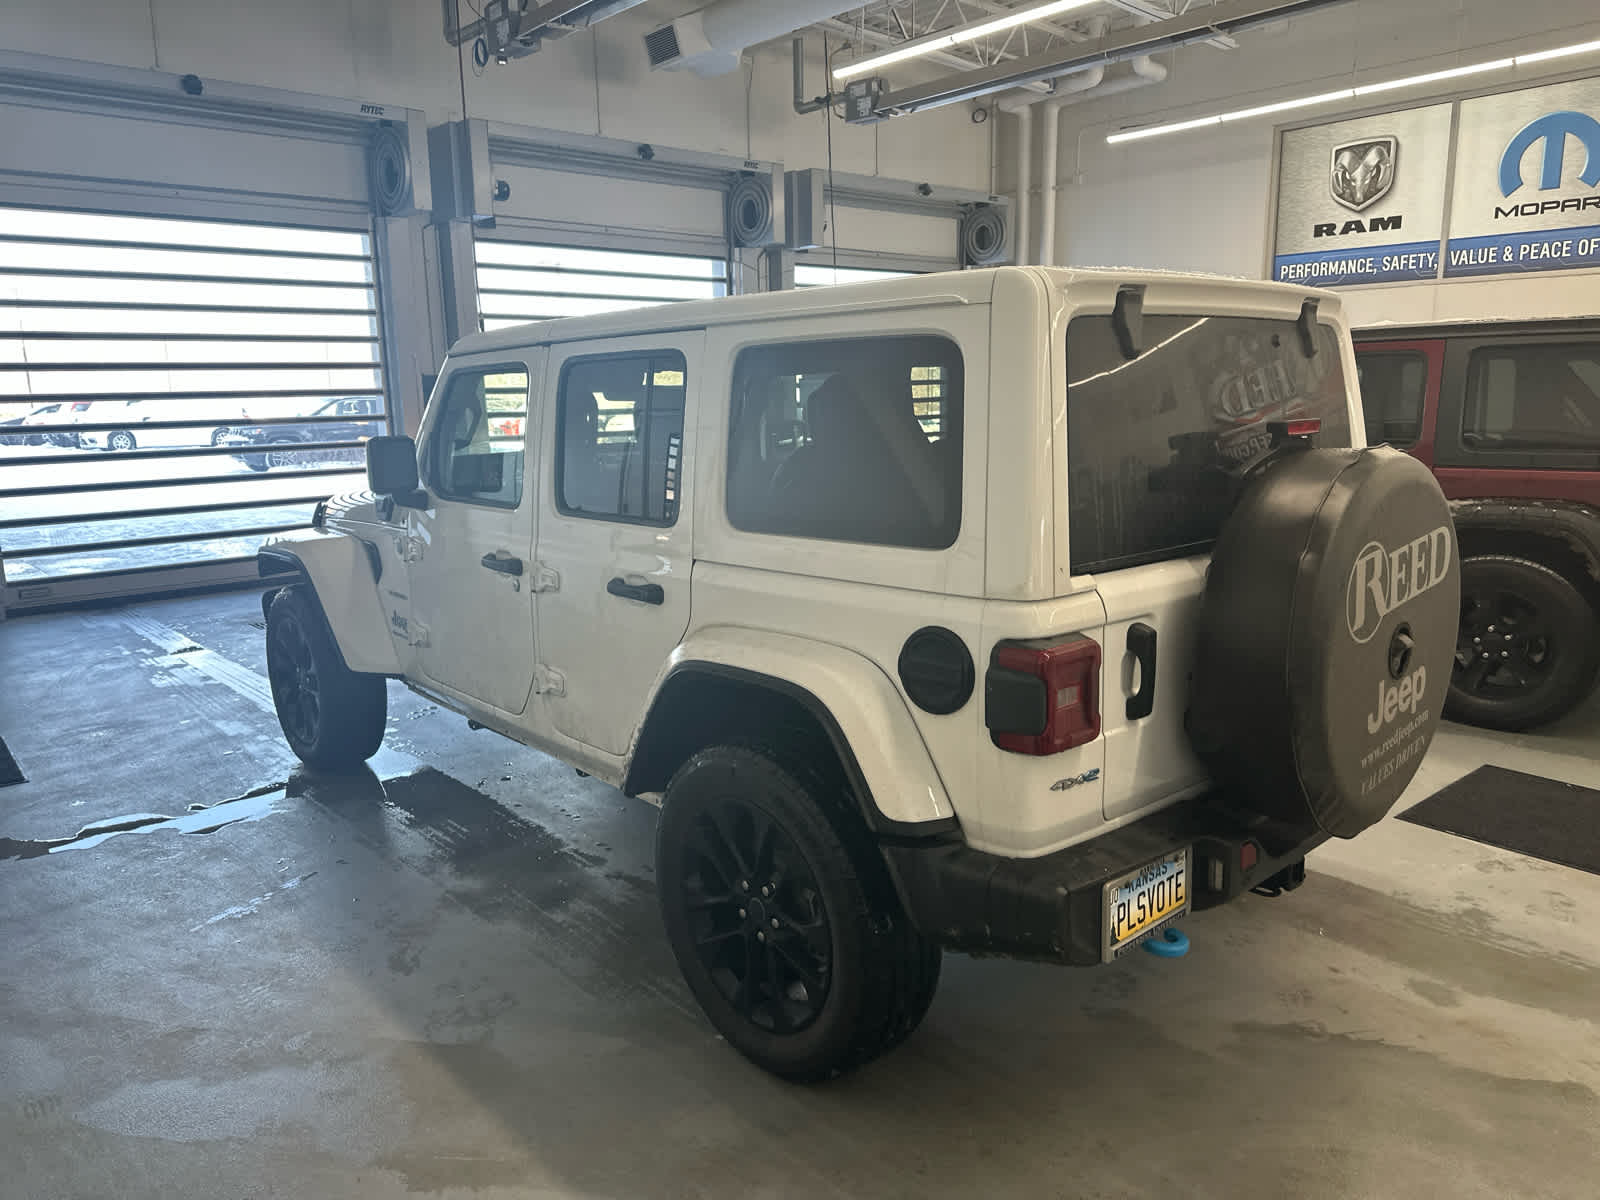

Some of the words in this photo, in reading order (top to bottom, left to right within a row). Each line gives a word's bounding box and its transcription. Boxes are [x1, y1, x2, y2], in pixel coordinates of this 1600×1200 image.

[1313, 215, 1402, 238] RAM
[1494, 196, 1600, 219] MOPAR
[1280, 257, 1377, 280] PERFORMANCE,
[1382, 252, 1439, 272] SAFETY,
[1450, 243, 1498, 266] VALUE
[1502, 246, 1513, 261] &
[1519, 240, 1571, 259] PEACE
[1578, 238, 1599, 256] OF
[1351, 526, 1451, 633] REED
[1367, 665, 1426, 735] Jeep
[1127, 863, 1168, 893] KANSAS
[1117, 869, 1184, 937] PLSVOTE
